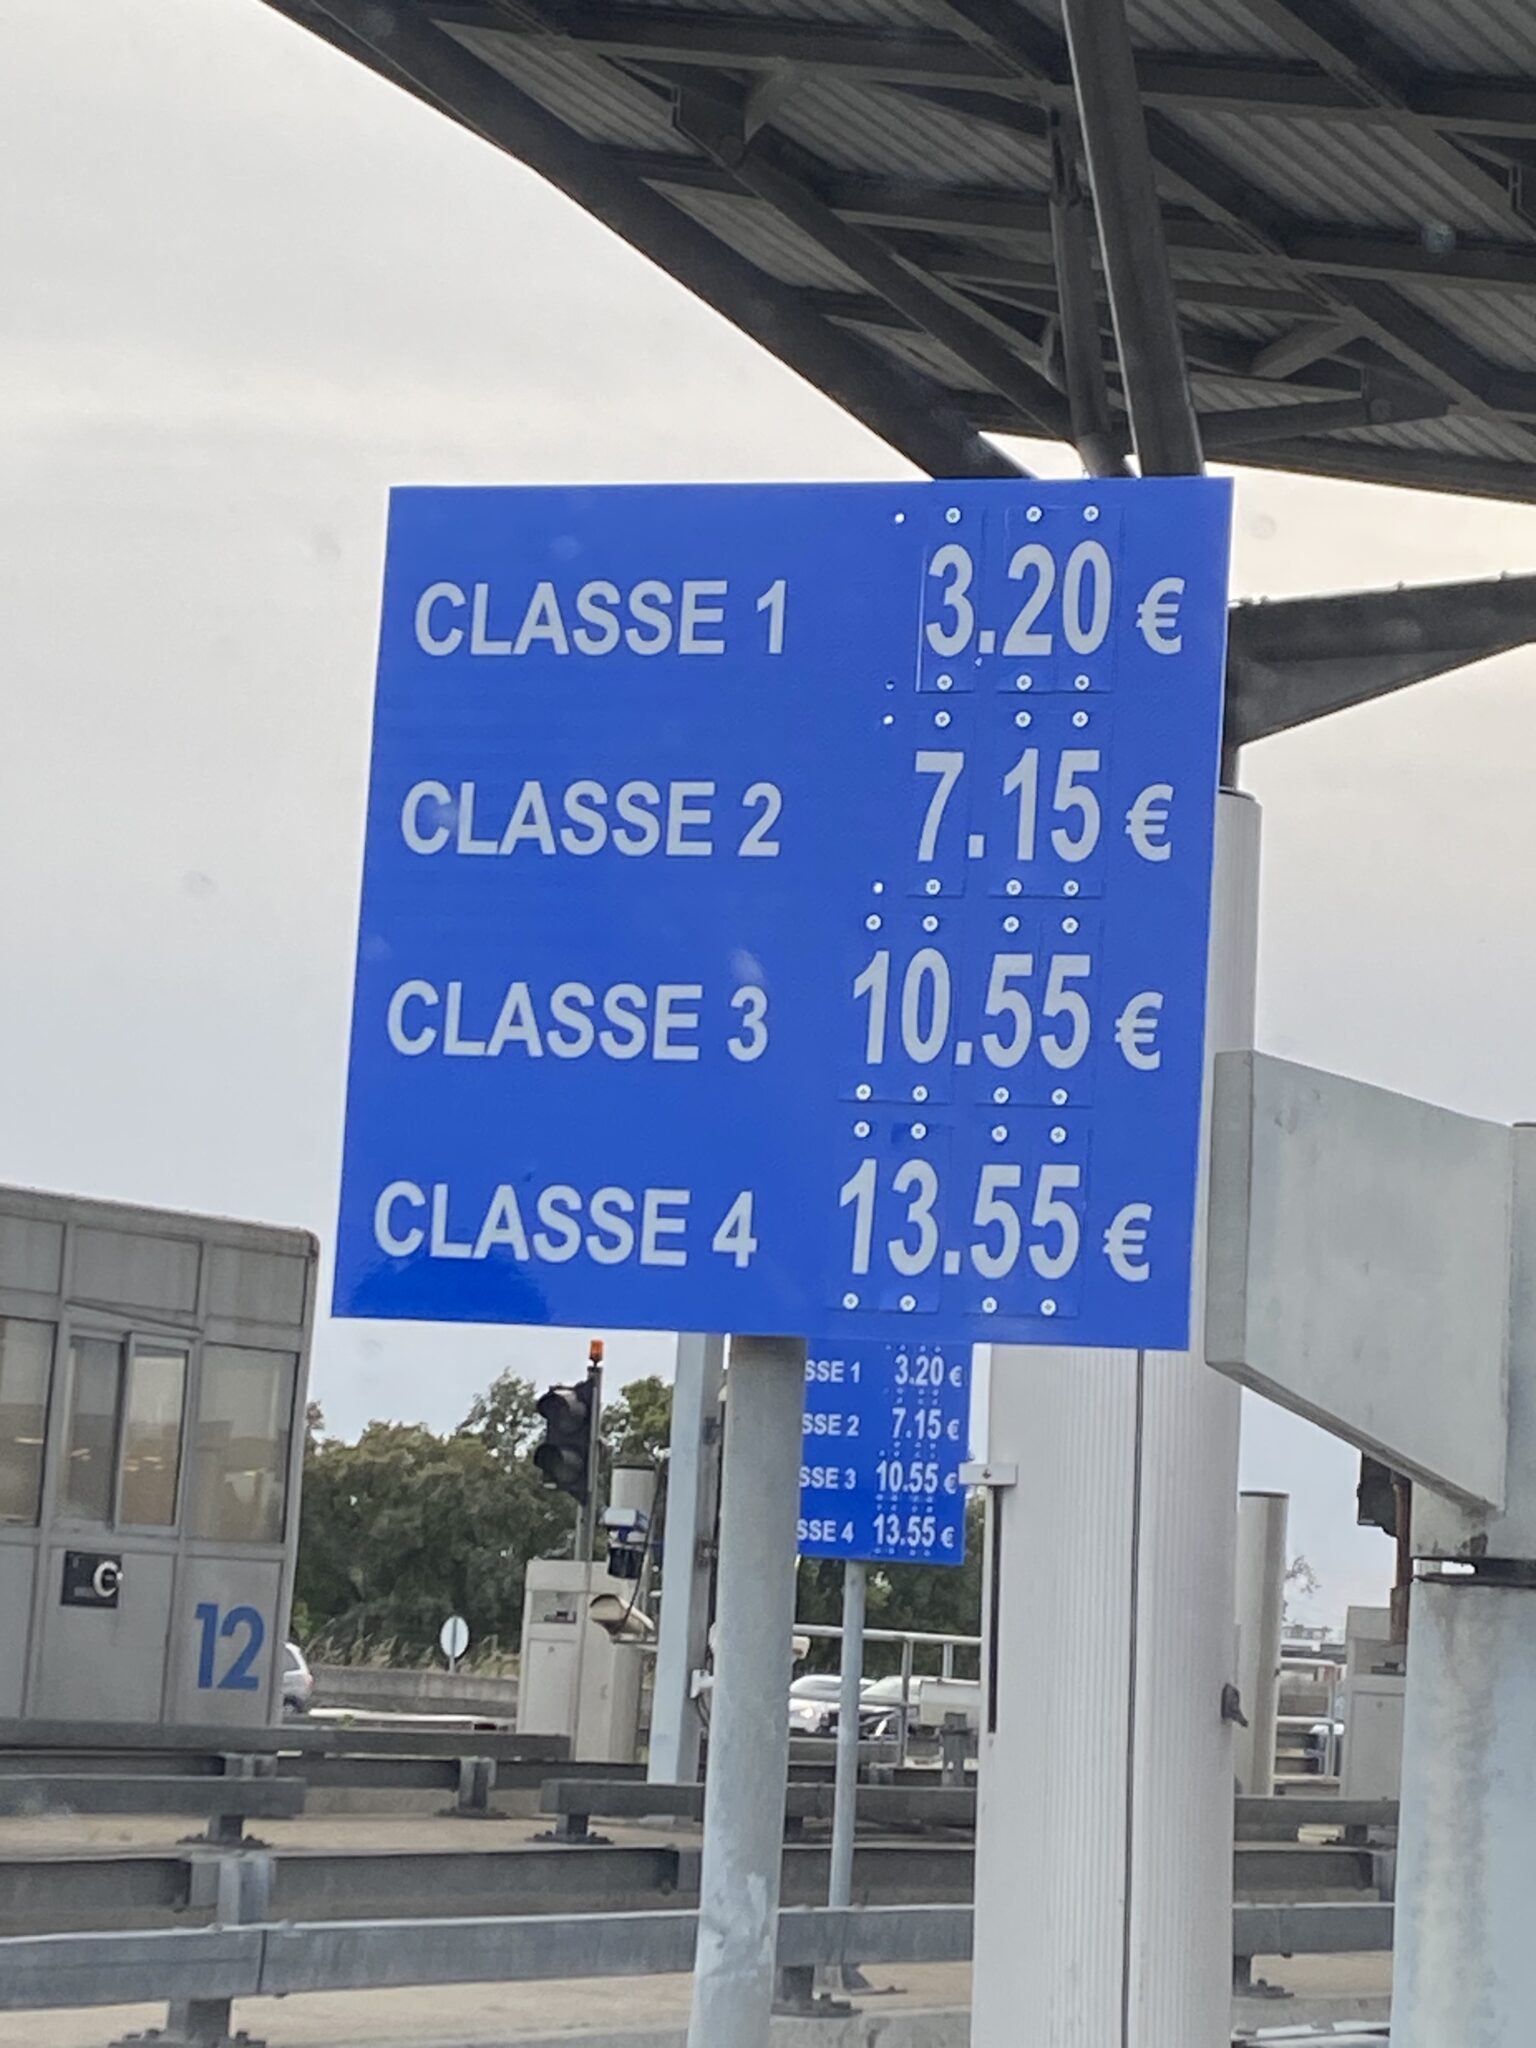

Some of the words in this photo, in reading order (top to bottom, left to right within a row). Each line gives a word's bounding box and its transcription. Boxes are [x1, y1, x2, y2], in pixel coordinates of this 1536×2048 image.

[415, 580, 727, 656] CLASSE
[757, 580, 786, 654] 1
[926, 540, 1112, 657] 3.20
[1136, 577, 1185, 654] €
[402, 780, 715, 855] CLASSE
[739, 782, 782, 856] 2
[915, 748, 1100, 862] 7.15
[1125, 784, 1173, 861] €
[388, 980, 702, 1061] CLASSE
[728, 986, 767, 1062] 3
[853, 948, 1090, 1069] 10.55
[1115, 992, 1163, 1070] €
[375, 1181, 690, 1265] CLASSE
[713, 1191, 757, 1267] 4
[840, 1158, 1080, 1279] 13.55
[1103, 1203, 1152, 1282] €
[805, 1360, 844, 1383] SSE
[850, 1361, 860, 1383] 1
[895, 1355, 944, 1386] 3.20
[949, 1365, 962, 1388] €
[802, 1413, 842, 1436] SSE
[847, 1415, 860, 1436] 2
[892, 1407, 942, 1440] 7.15
[946, 1419, 960, 1440] €
[800, 1466, 839, 1489] SSE
[844, 1468, 857, 1490] 3
[876, 1460, 939, 1493] 10.55
[943, 1472, 957, 1494] €
[797, 1519, 837, 1542] SSE
[841, 1521, 854, 1543] 4
[873, 1513, 936, 1547] 13.55
[940, 1526, 955, 1548] €
[194, 1602, 266, 1691] 12
